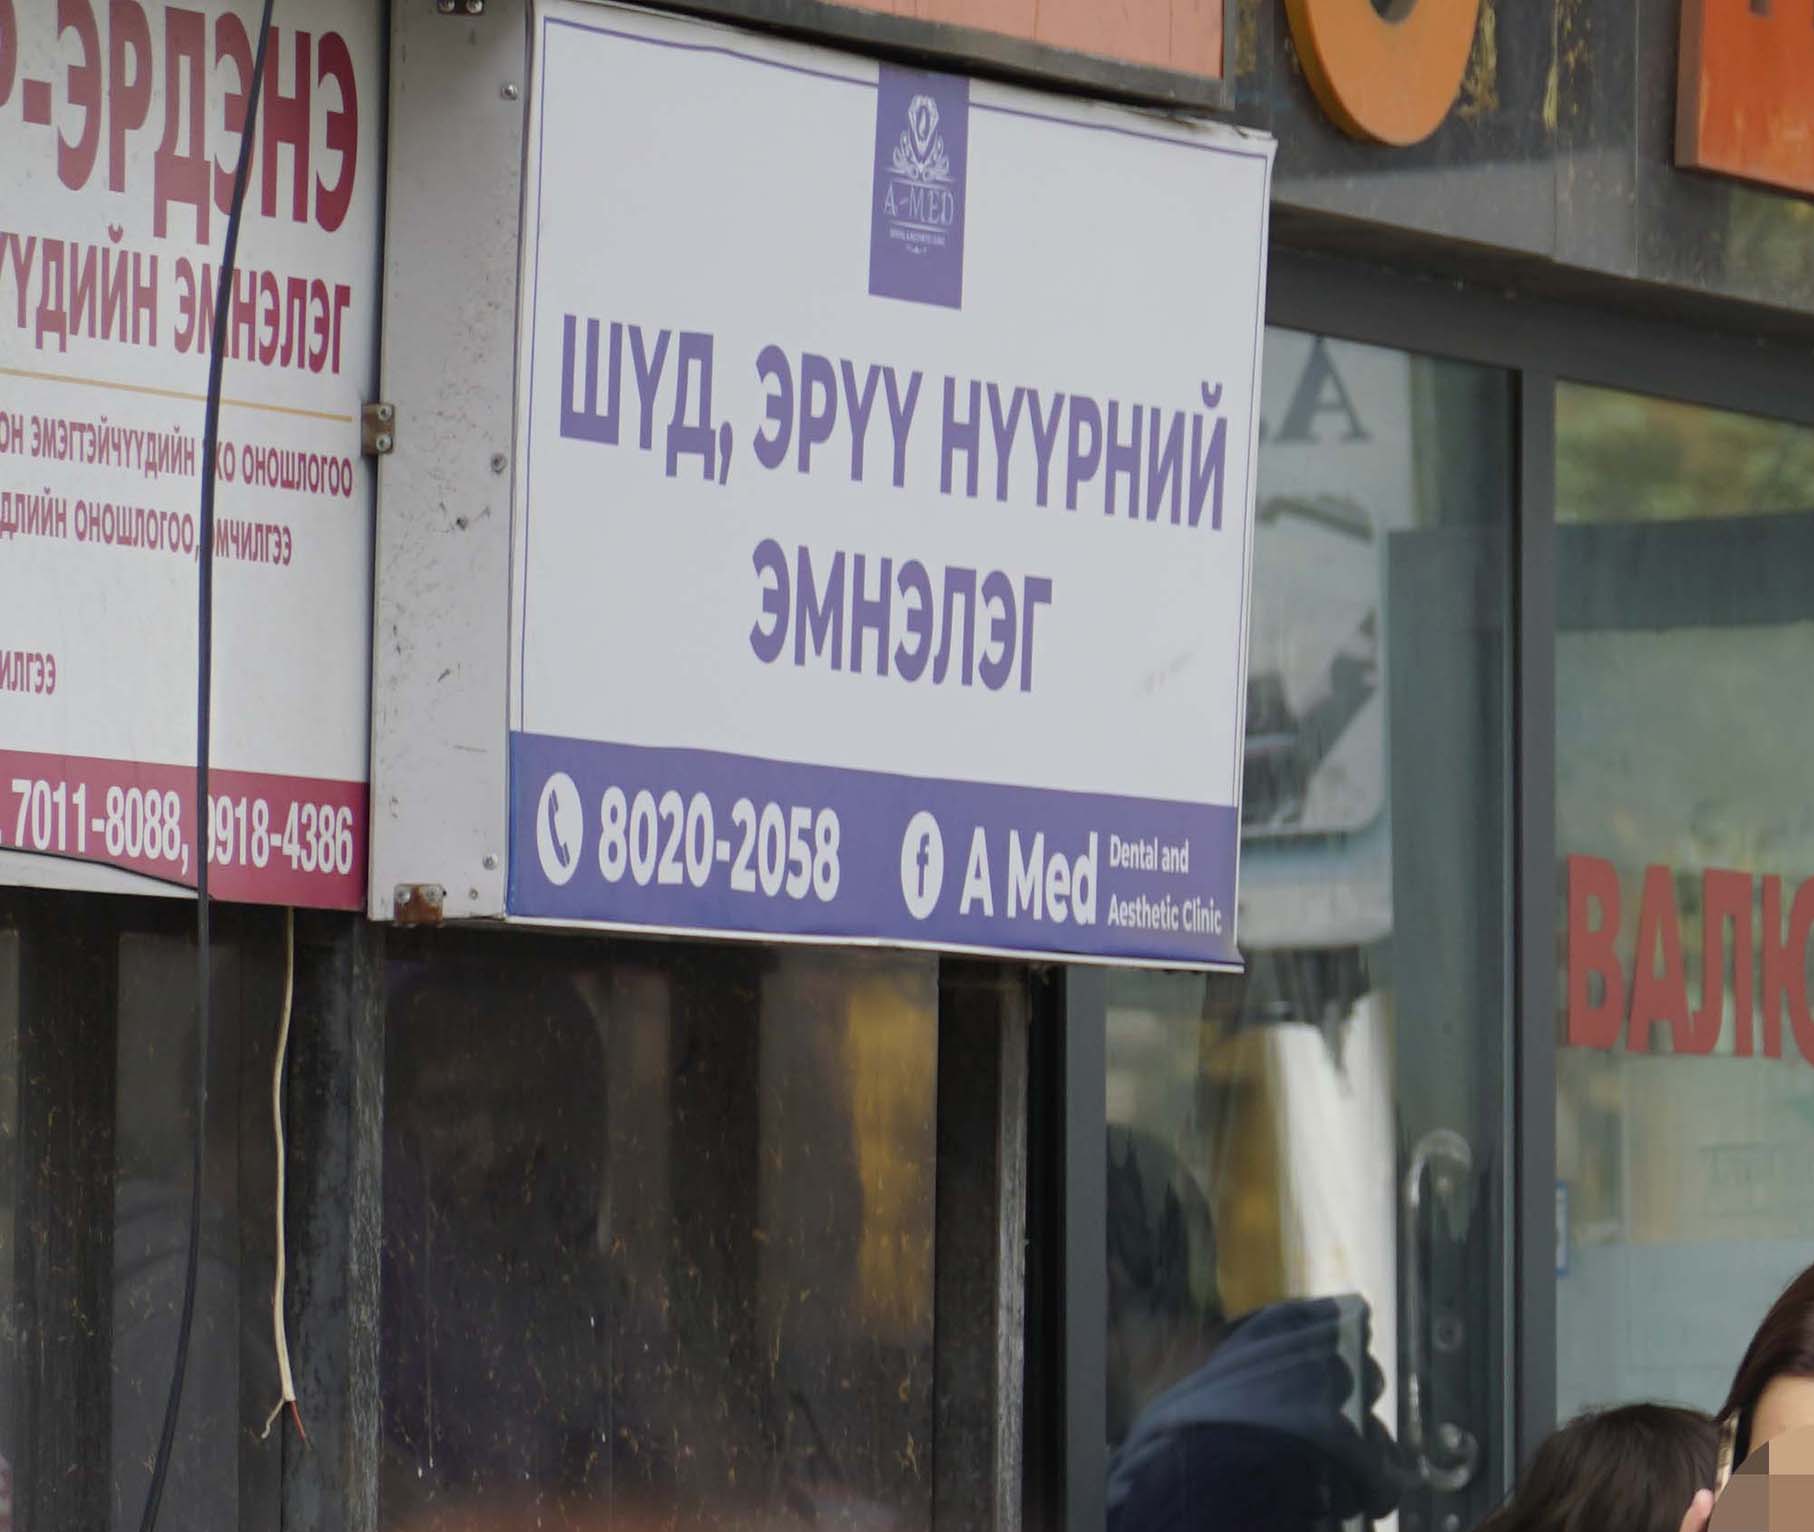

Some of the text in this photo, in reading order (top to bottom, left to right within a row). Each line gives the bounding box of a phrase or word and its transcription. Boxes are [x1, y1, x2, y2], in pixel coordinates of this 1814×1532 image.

[0, 0, 358, 245] -ЭРДЭНЭ
[174, 257, 351, 374] ЭМНЭЛЭГ
[242, 445, 352, 498] ОНОШЛОГОО
[560, 313, 1228, 532] ШҮД, ЭРҮҮ НҮҮРНИЙ
[212, 518, 292, 566] МЧИЛГЭЭ
[750, 538, 1053, 693] ЭМНЭЛЭГ
[12, 779, 189, 875] 7011-8088,
[600, 786, 1098, 925] 8020-2058 A Med
[1110, 834, 1189, 874] Dental and
[1107, 893, 1222, 935] Aesthetic Clinic
